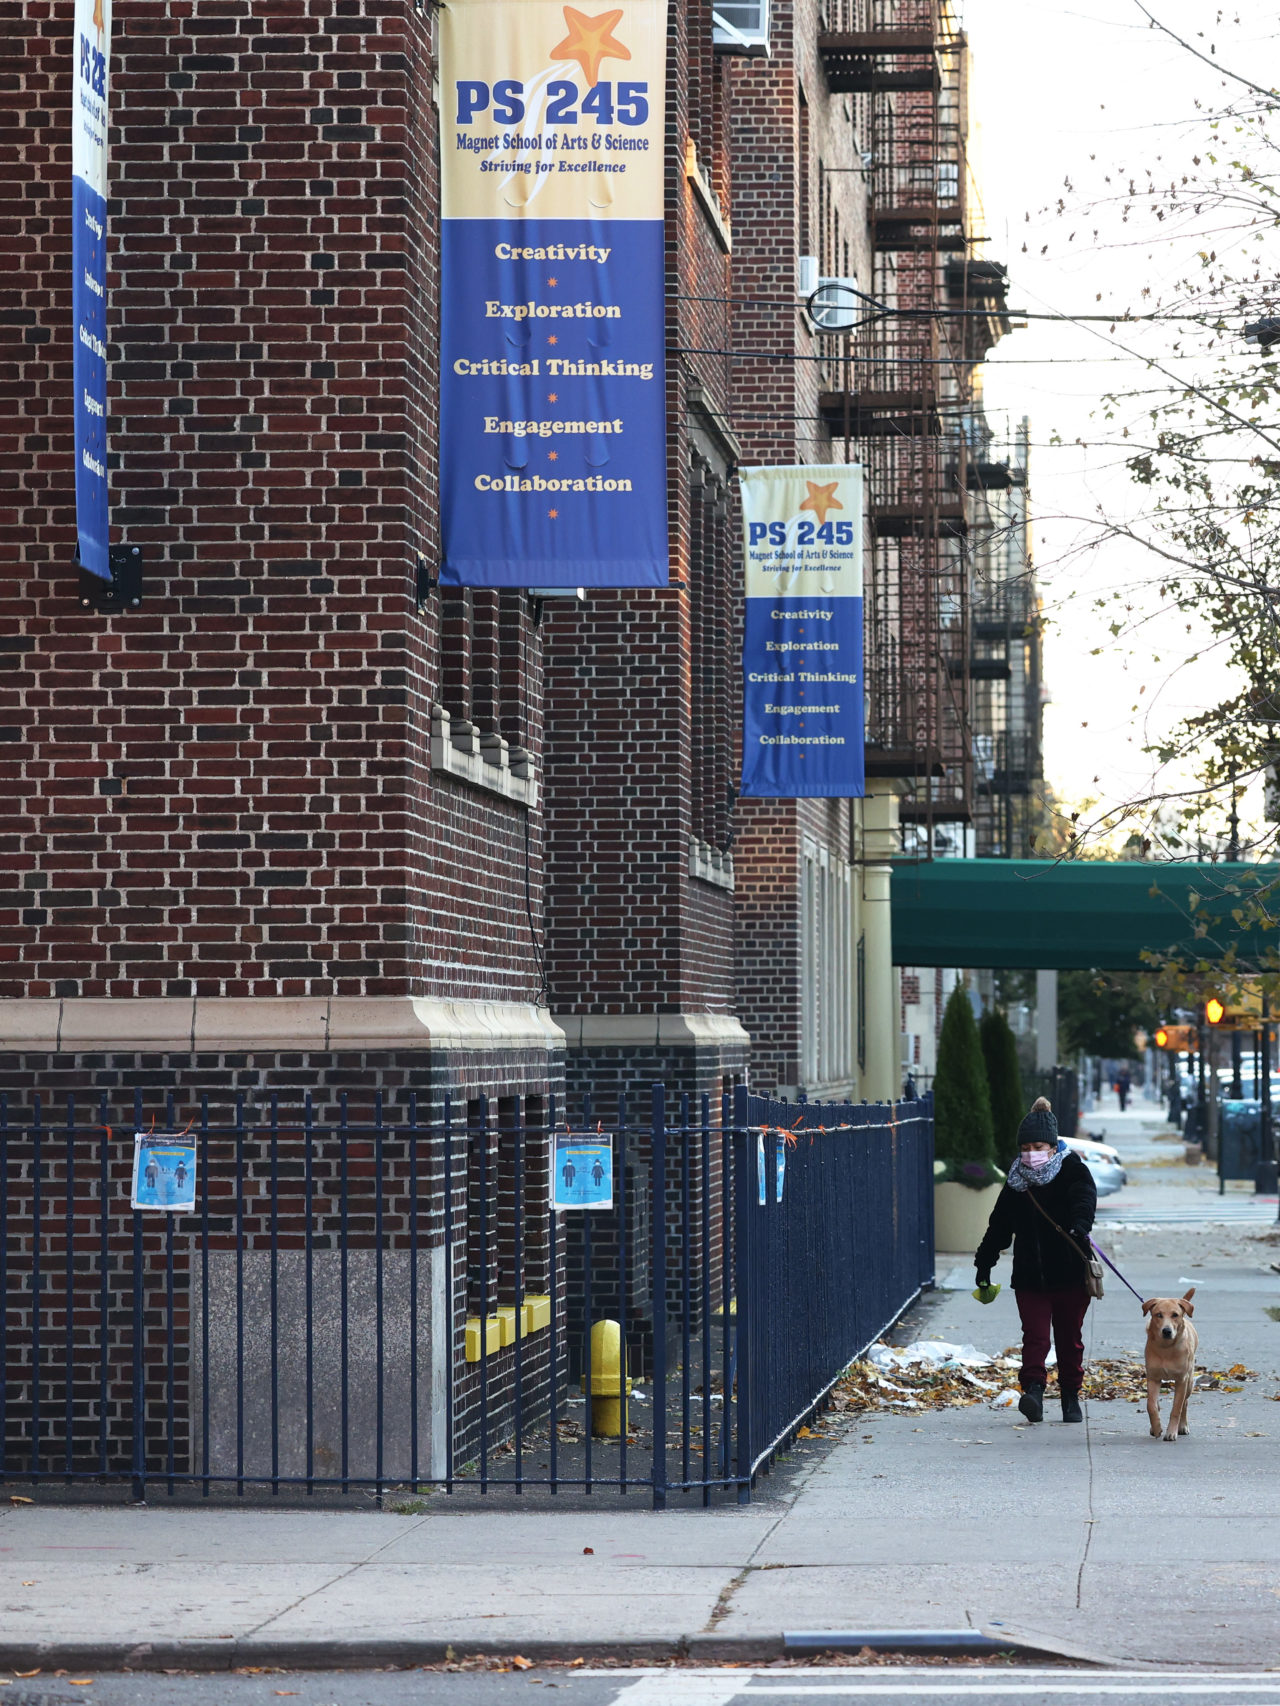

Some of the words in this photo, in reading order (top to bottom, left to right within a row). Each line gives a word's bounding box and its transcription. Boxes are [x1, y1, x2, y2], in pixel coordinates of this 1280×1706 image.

[456, 80, 525, 125] PS
[546, 80, 649, 126] 245
[456, 133, 499, 154] Magnet
[502, 133, 542, 150] School
[545, 133, 558, 150] of
[560, 133, 588, 150] Arts
[591, 132, 602, 150] &
[604, 133, 649, 151] Science
[480, 160, 532, 174] Striving
[535, 160, 555, 174] for
[558, 160, 627, 173] Excellence
[494, 243, 612, 263] Creativity
[485, 301, 621, 321] Exploration
[453, 358, 540, 376] Critical
[546, 358, 654, 380] Thinking
[484, 417, 623, 437] Engagement
[474, 474, 633, 492] Collaboration
[749, 521, 786, 546] PS
[797, 521, 853, 545] 245
[774, 550, 796, 560] School
[771, 610, 834, 621] Creativity
[765, 641, 839, 652] Exploration
[748, 672, 794, 683] Critical
[798, 672, 857, 684] Thinking
[764, 703, 840, 715] Engagement
[759, 735, 845, 745] Collaboration
